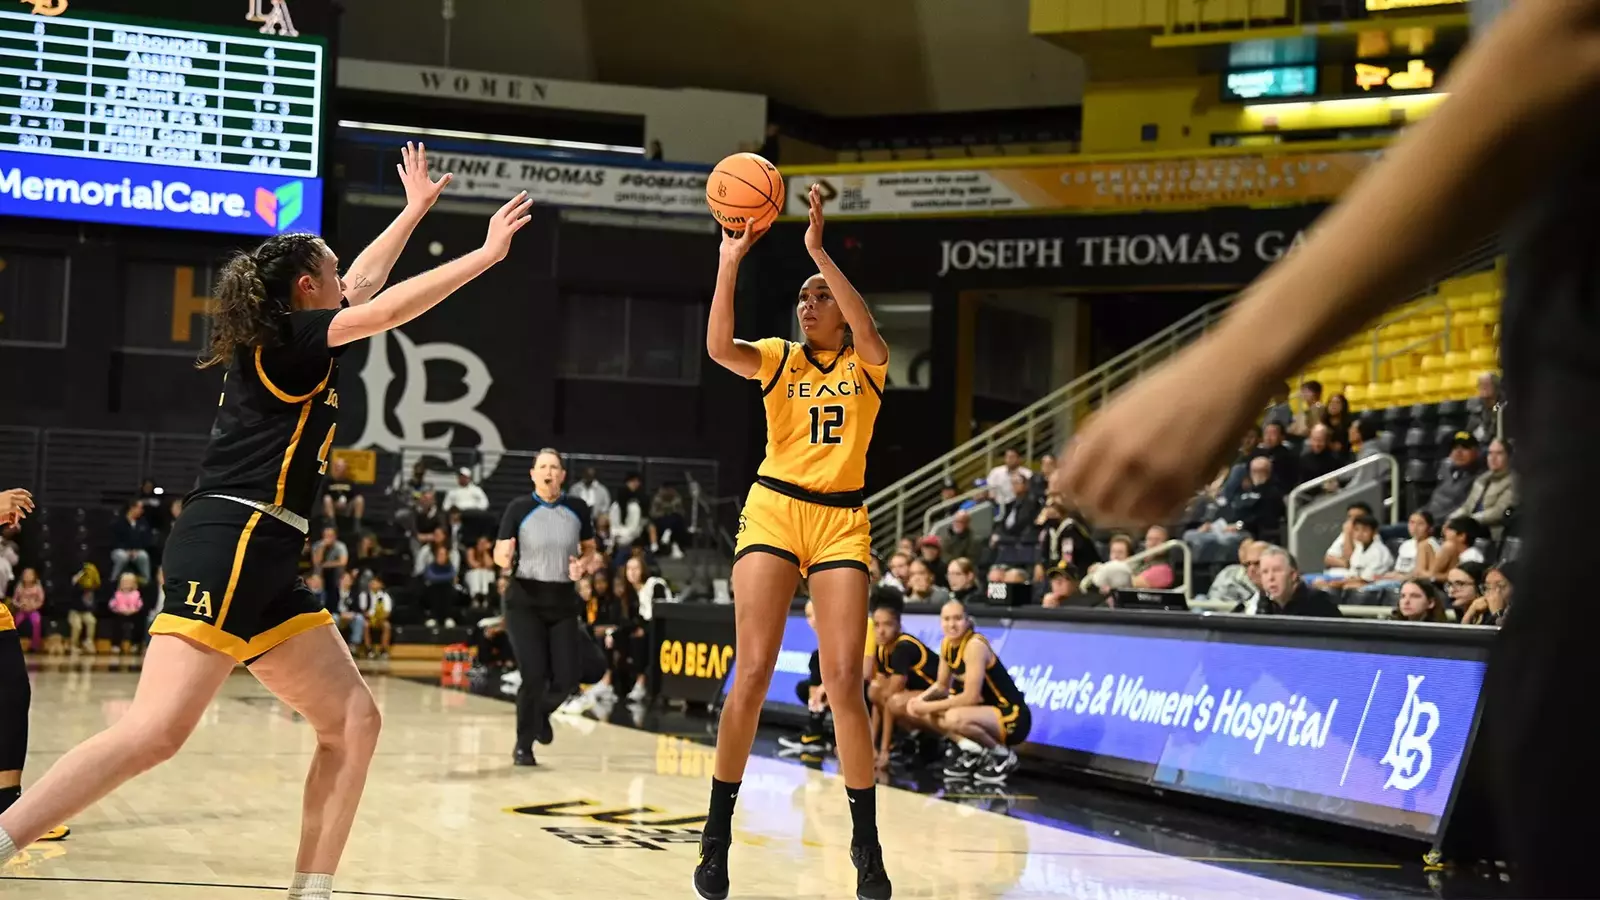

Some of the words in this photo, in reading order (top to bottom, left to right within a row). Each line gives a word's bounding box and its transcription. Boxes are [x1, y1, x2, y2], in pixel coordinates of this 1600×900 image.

[113, 30, 208, 54] Rebounds
[264, 46, 276, 60] 4
[125, 50, 192, 69] Assists
[128, 68, 185, 86] Steals
[418, 72, 548, 101] WOMEN
[105, 122, 154, 140] Field
[158, 127, 203, 143] Goal
[98, 140, 147, 157] Field
[151, 145, 195, 162] Goal
[521, 164, 607, 187] THOMAS
[936, 237, 1063, 277] JOSEPH
[1076, 232, 1241, 267] THOMAS
[787, 380, 865, 399] BEACH
[808, 404, 845, 445] 12
[184, 580, 213, 618] LA
[660, 639, 683, 675] GO
[1088, 674, 1115, 715] &
[1111, 673, 1215, 733] Women's
[1211, 687, 1339, 755] Hospital
